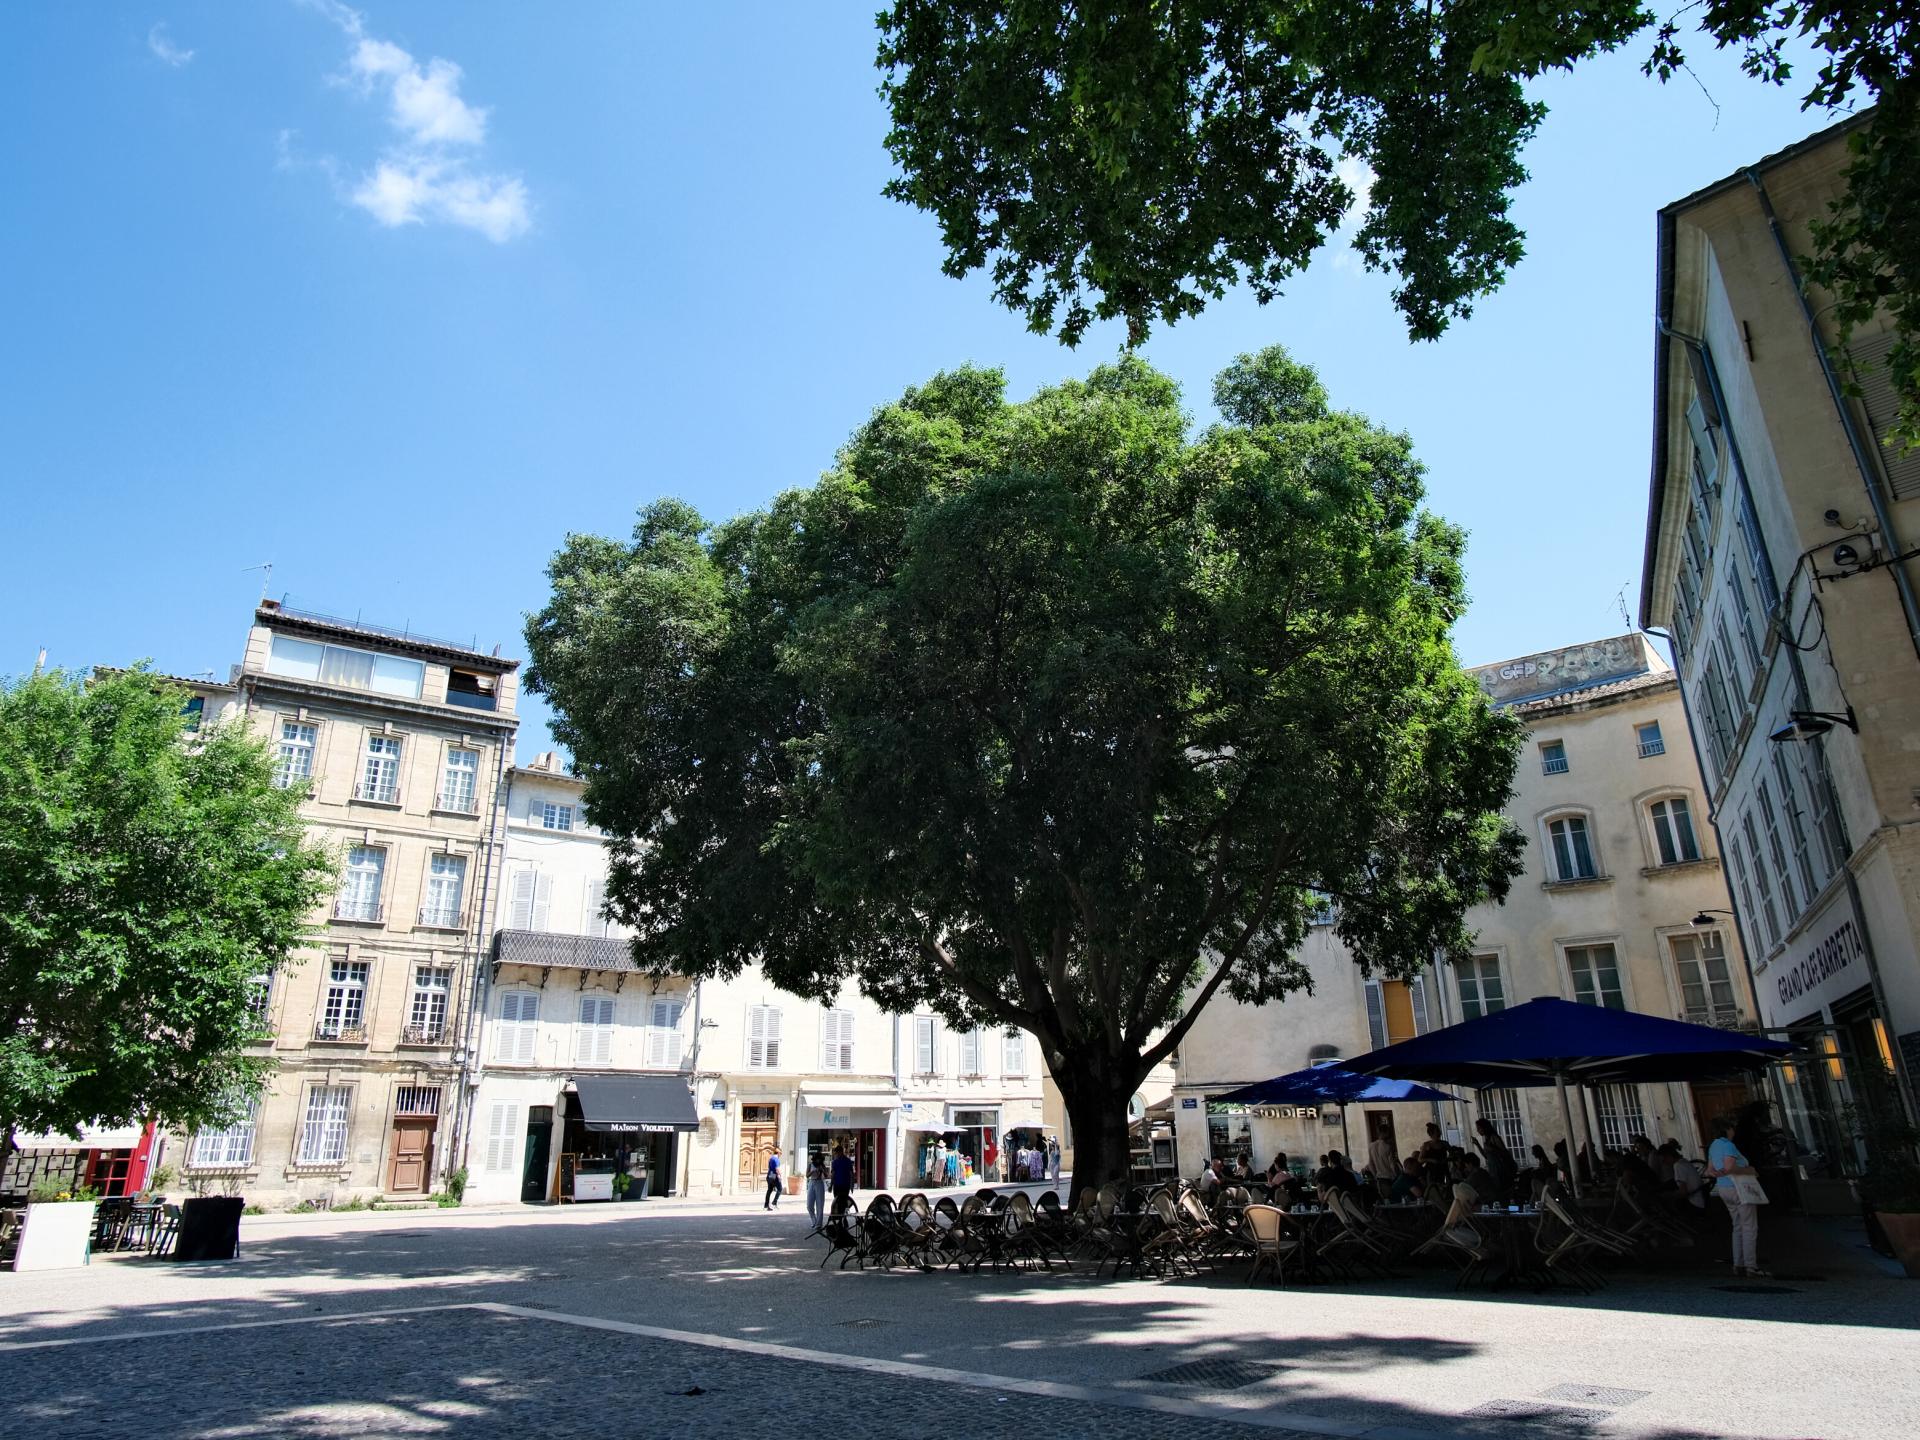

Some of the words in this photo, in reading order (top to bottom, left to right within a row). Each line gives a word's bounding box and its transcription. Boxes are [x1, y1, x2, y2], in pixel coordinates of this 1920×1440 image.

[1778, 966, 1803, 1005] GRAND
[1816, 919, 1864, 981] BARRETTA
[641, 1123, 675, 1133] VIOLETTE
